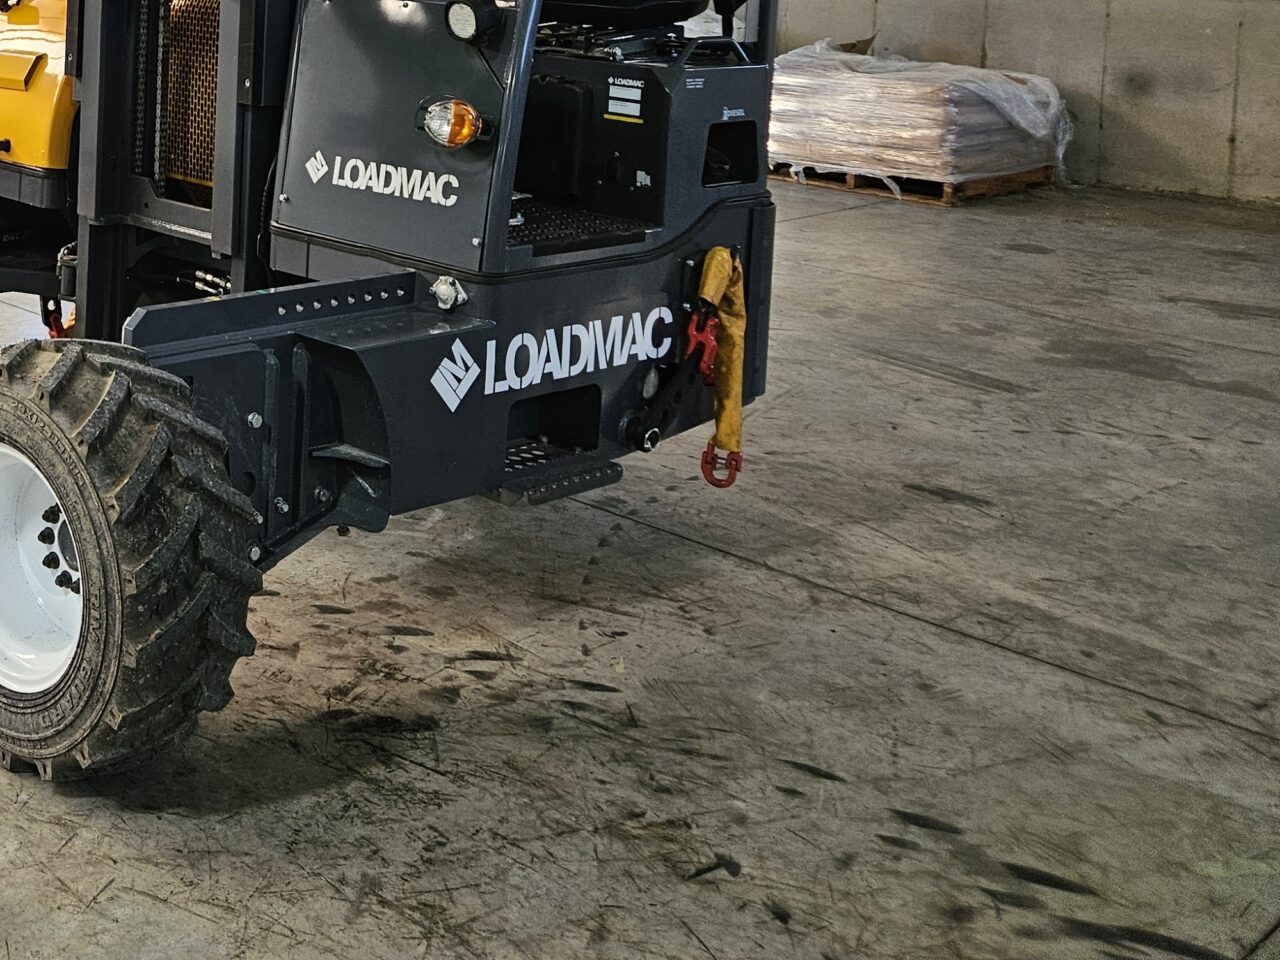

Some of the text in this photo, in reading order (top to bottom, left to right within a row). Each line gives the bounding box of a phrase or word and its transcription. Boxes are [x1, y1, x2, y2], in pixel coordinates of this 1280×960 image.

[614, 77, 645, 88] LOADMAC
[332, 155, 460, 207] LOADMAC
[484, 306, 674, 395] LOADMAC
